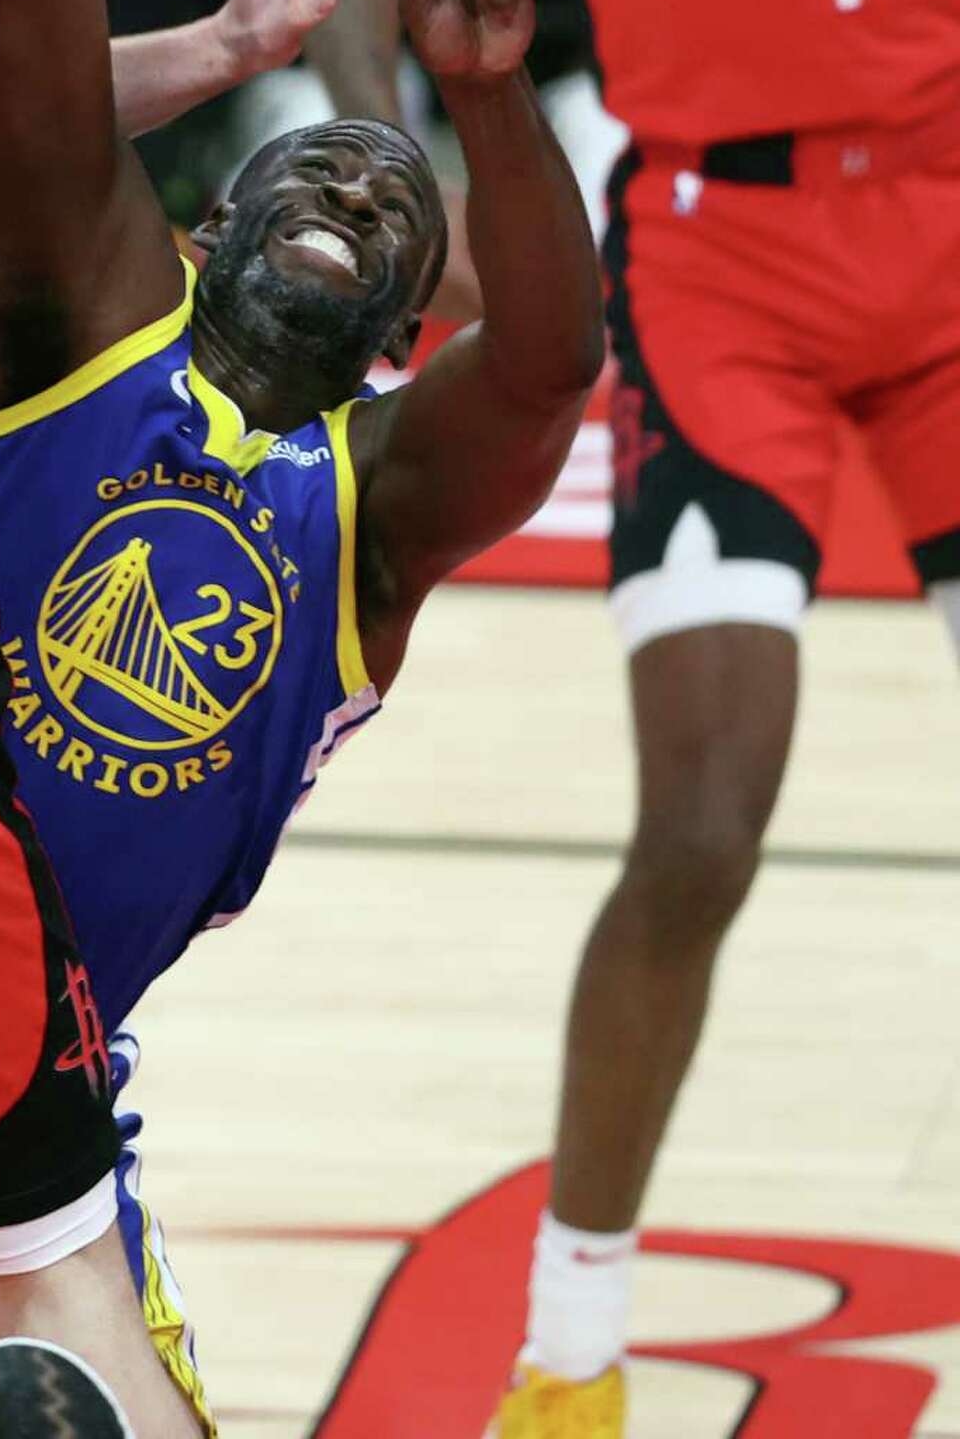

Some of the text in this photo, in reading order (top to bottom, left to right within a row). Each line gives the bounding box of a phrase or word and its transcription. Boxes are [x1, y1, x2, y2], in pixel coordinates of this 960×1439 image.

[96, 463, 300, 603] GOLDEN STE
[170, 583, 275, 670] 23
[0, 636, 233, 798] WARRIORS
